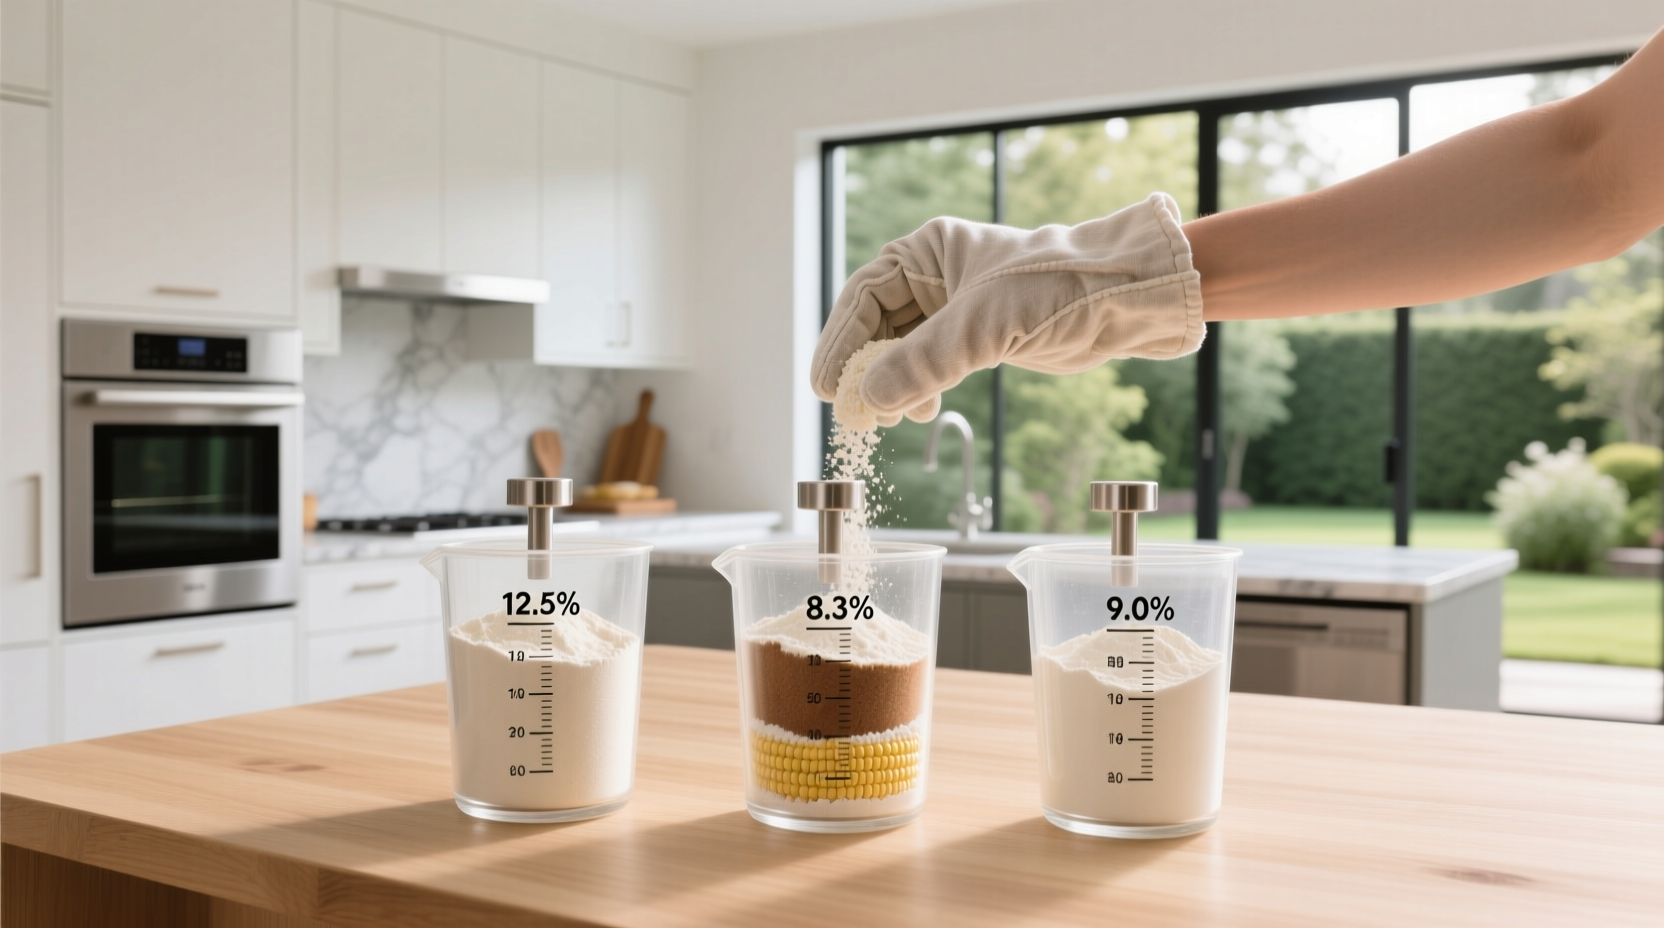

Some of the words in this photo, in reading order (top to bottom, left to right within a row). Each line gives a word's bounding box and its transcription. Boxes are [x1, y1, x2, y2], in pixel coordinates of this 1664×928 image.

[502, 591, 580, 616] 12.5%
[806, 595, 874, 620] 8.3%
[1106, 595, 1174, 621] 9.0%
